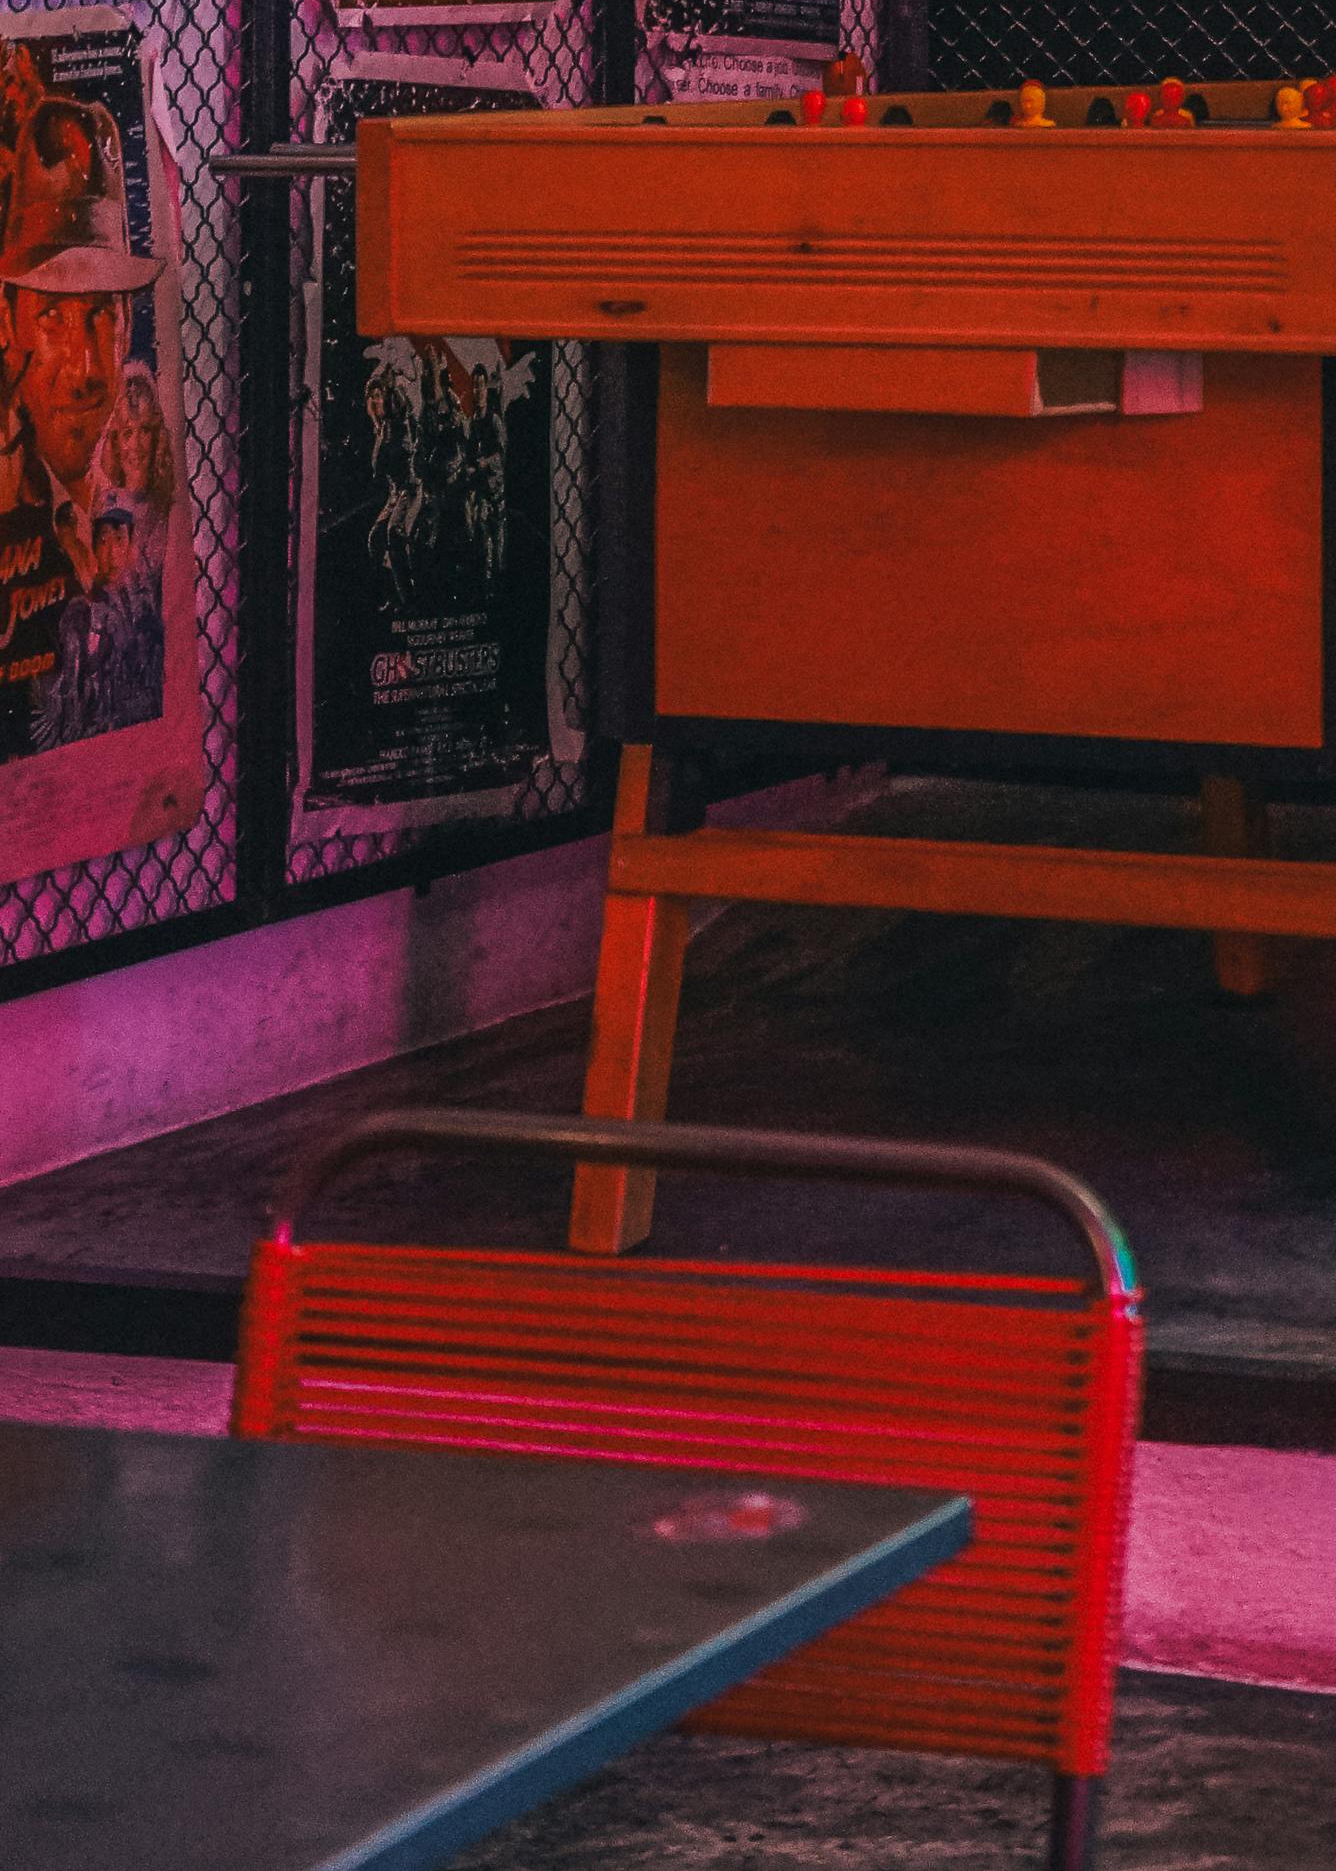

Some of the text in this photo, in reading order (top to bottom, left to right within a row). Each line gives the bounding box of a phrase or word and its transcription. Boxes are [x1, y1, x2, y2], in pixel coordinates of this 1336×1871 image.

[723, 55, 764, 73] Choose
[766, 62, 774, 73] a
[698, 78, 738, 97] Choose
[743, 84, 751, 97] a
